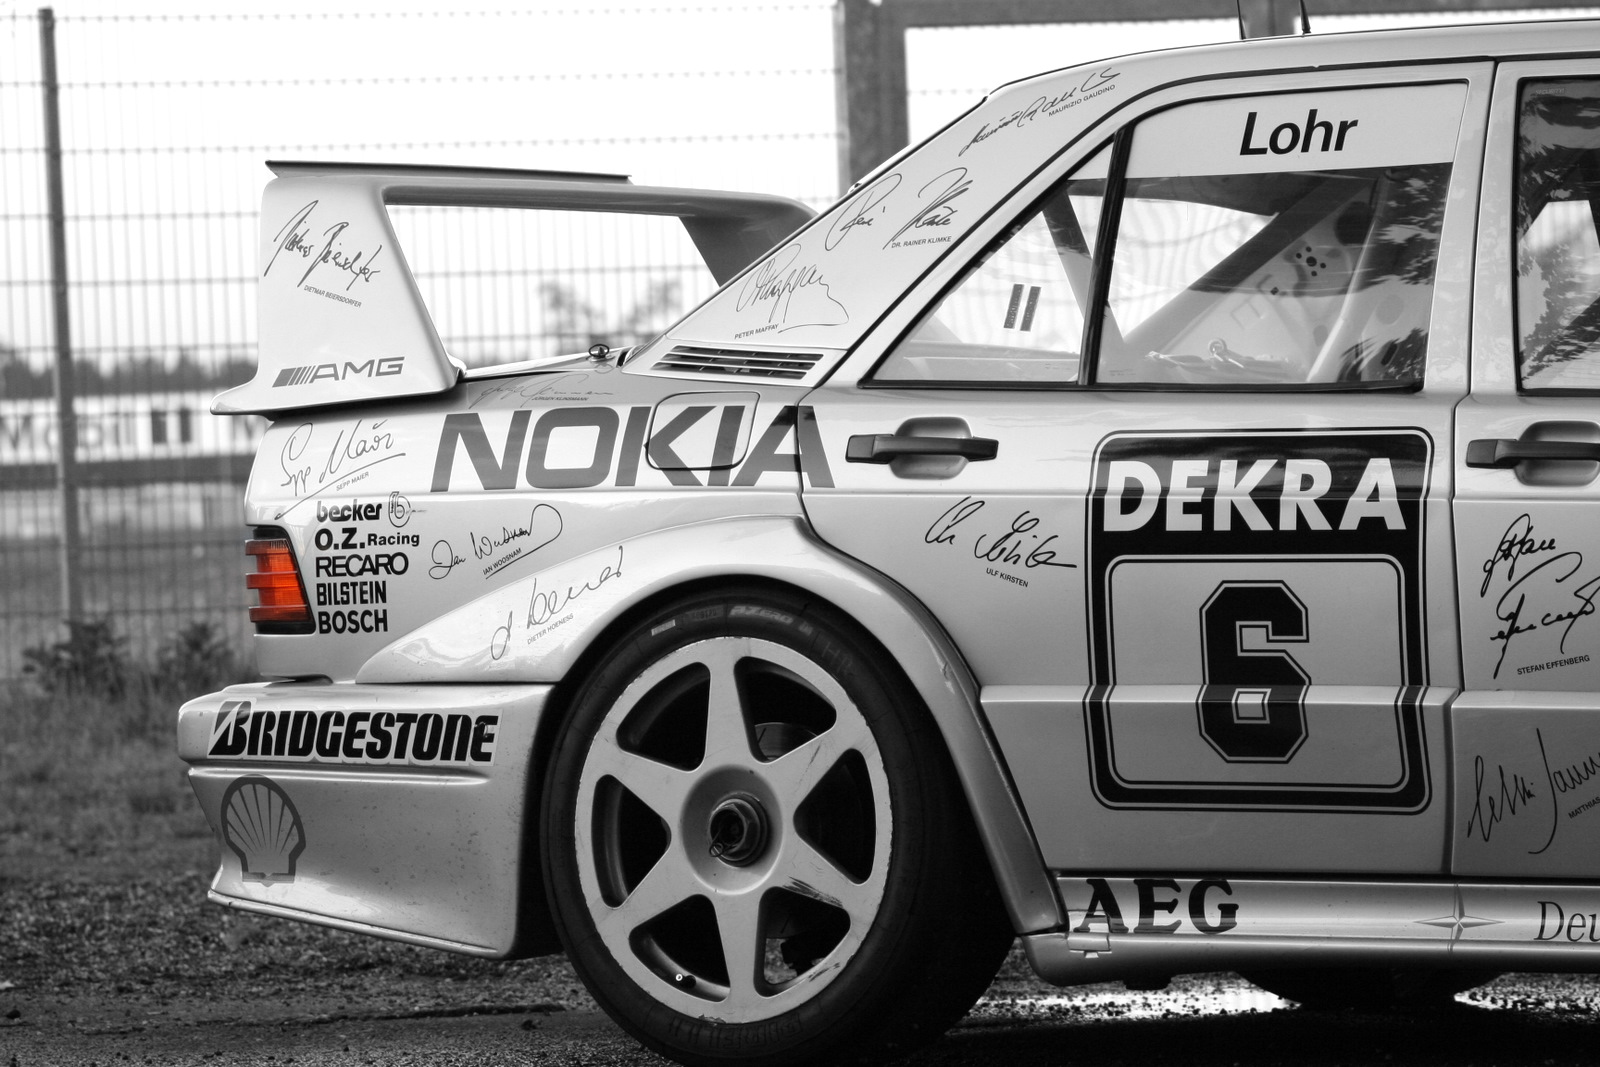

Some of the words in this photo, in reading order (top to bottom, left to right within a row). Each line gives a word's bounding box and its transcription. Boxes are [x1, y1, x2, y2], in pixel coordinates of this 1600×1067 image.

[1048, 98, 1082, 117] MAURIZIO
[1083, 84, 1116, 101] GAUDINO
[1240, 109, 1359, 155] Lohr
[903, 238, 927, 247] RAINER
[927, 236, 952, 244] KLIMKE
[303, 284, 326, 296] DIETMAR
[325, 291, 362, 308] BEIERSDORFER
[734, 329, 755, 340] PETER
[755, 323, 779, 334] MAFFAY
[309, 356, 405, 385] AMG
[430, 405, 835, 492] NOKIA
[336, 479, 350, 491] SEPP
[351, 471, 369, 484] MAIER
[1103, 457, 1407, 531] DEKRA
[317, 499, 382, 522] becker
[316, 552, 409, 578] RECARO
[483, 565, 493, 575] IAN
[493, 547, 521, 568] WOOSNAM
[986, 567, 999, 576] ULF
[1000, 572, 1028, 587] KIRSTEN
[317, 581, 387, 606] BILSTEIN
[318, 609, 388, 634] BOSCH
[527, 629, 547, 645] DIETER
[547, 613, 573, 632] HOENESS
[1196, 580, 1311, 764] 6
[1517, 664, 1545, 675] STEFAN
[1546, 655, 1590, 669] EFFENBERG
[208, 701, 499, 762] BRIDGESTONE
[1568, 796, 1600, 819] MATTHIAS
[1073, 878, 1239, 934] AEG
